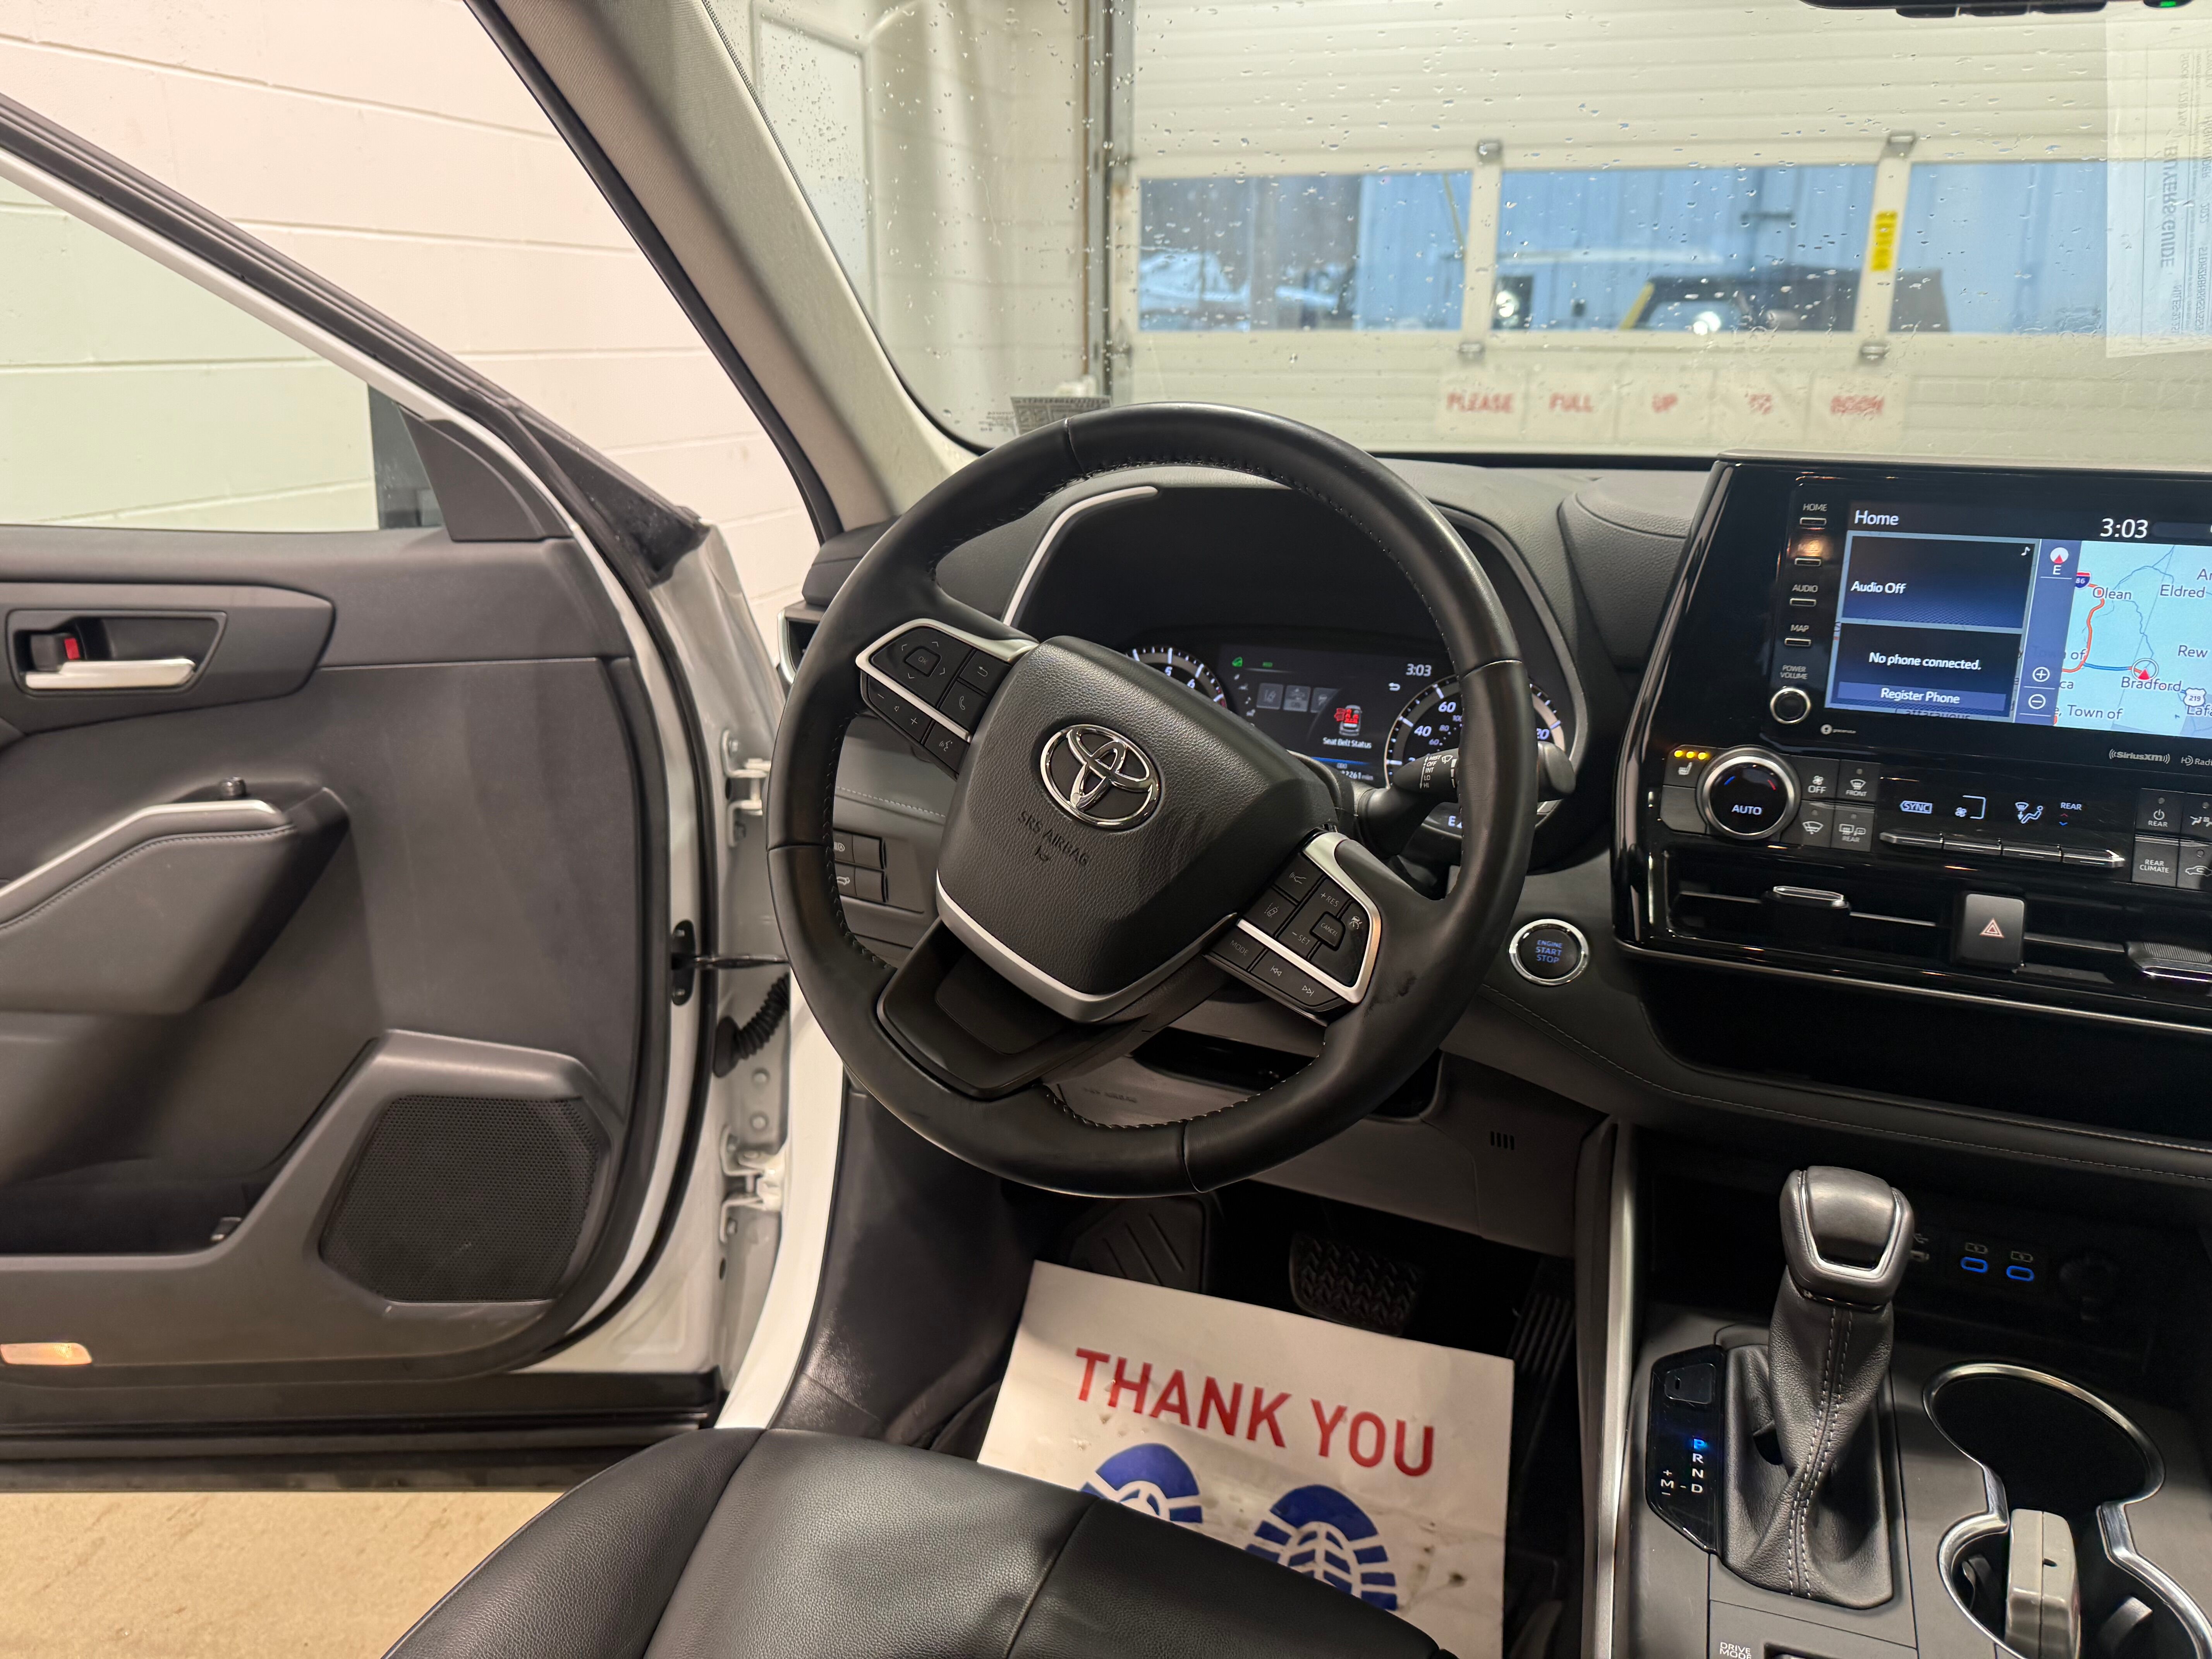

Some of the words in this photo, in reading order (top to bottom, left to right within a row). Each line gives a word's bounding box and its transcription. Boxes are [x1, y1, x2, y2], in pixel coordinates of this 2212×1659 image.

[1446, 392, 1515, 414] PLEASE
[1803, 503, 1827, 512] HOME
[1854, 510, 1899, 526] Home
[2100, 518, 2148, 539] 3:03
[2052, 565, 2061, 575] E
[1791, 584, 1819, 593] AUDIO
[1850, 581, 1883, 593] Audio
[1884, 582, 1907, 594] Off
[2092, 586, 2132, 600] Olean
[2159, 584, 2205, 598] Eldred
[1790, 624, 1810, 632] MAP
[2071, 649, 2087, 660] of
[2178, 645, 2208, 658] Rew
[918, 656, 927, 665] OK
[1869, 652, 1886, 664] No
[1887, 654, 1921, 666] phone
[1922, 657, 1982, 671] connected.
[1164, 666, 1173, 676] 5
[1405, 663, 1432, 677] 3:03
[1782, 665, 1806, 673] POWER
[2121, 677, 2182, 692] Bradford
[1880, 687, 1923, 702] Register
[1925, 691, 1960, 704] Phone
[1438, 701, 1456, 713] 60
[2067, 704, 2104, 718] Town
[2107, 708, 2124, 720] of
[1414, 725, 1432, 737] 40
[1322, 737, 1337, 746] Seat
[1337, 738, 1351, 747] Belt
[1352, 739, 1372, 749] Status
[1808, 786, 1827, 794] OFF
[1731, 804, 1762, 815] AUTO
[1903, 802, 1930, 812] SYNC
[2060, 802, 2082, 811] REAR
[1448, 815, 1456, 827] E
[2139, 864, 2169, 873] CLIMATE
[1326, 895, 1340, 907] RES
[1320, 922, 1339, 936] CANCEL
[1298, 934, 1311, 946] SET
[1537, 939, 1562, 948] ENGINE
[1230, 939, 1249, 956] MODE
[1535, 946, 1562, 956] START
[1536, 954, 1559, 963] STOP
[1075, 1347, 1292, 1448] THANK
[1309, 1398, 1435, 1477] YOU
[1692, 1453, 1704, 1463] R
[1692, 1468, 1704, 1478] N
[1660, 1479, 1674, 1489] M
[1691, 1483, 1703, 1493] D
[1719, 1648, 1752, 1659] MODE
[1720, 1642, 1751, 1655] DRIVE
